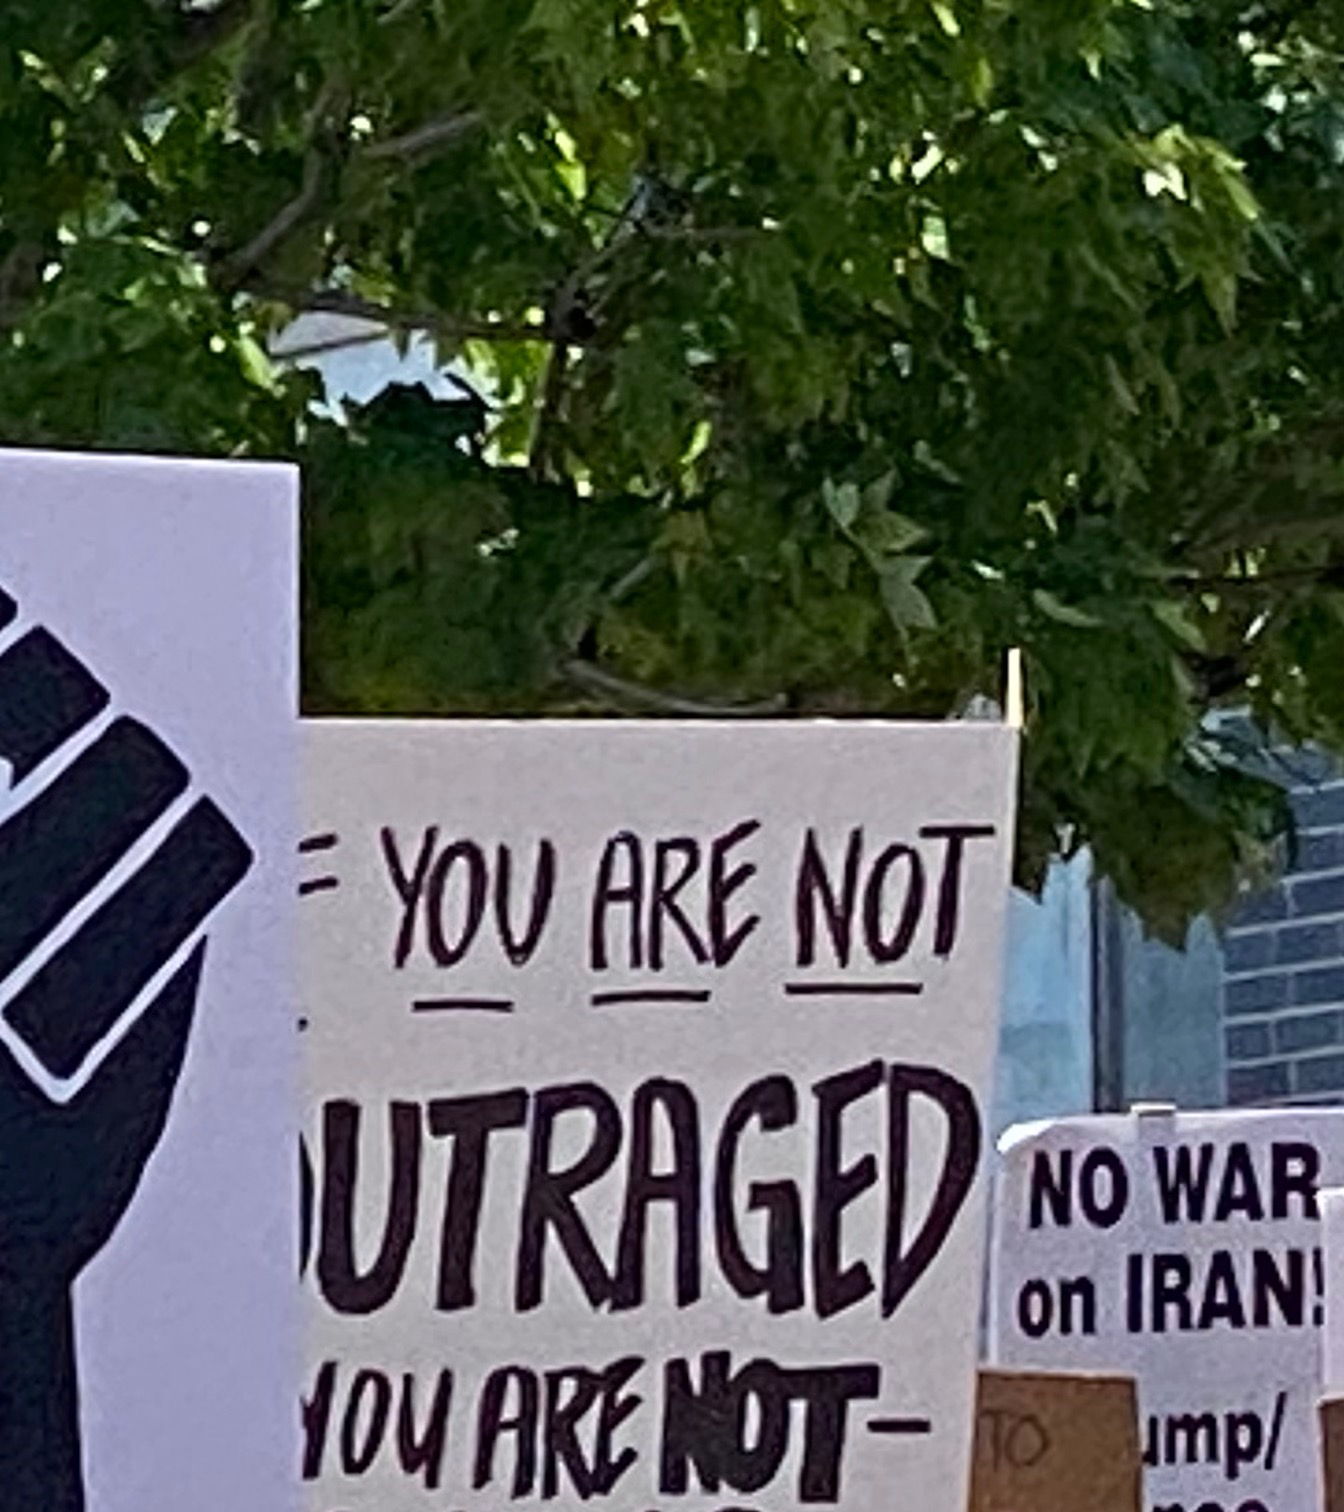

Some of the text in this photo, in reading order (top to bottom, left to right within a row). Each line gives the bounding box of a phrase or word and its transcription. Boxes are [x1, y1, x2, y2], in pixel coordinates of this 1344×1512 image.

[380, 826, 554, 970] YOU
[591, 820, 760, 970] ARE
[794, 824, 996, 968] NOT
[299, 1058, 982, 1318] UTRAGED
[1028, 1142, 1321, 1228] NO WAR
[1018, 1246, 1325, 1338] on IRAN!
[474, 1356, 646, 1500] ARE
